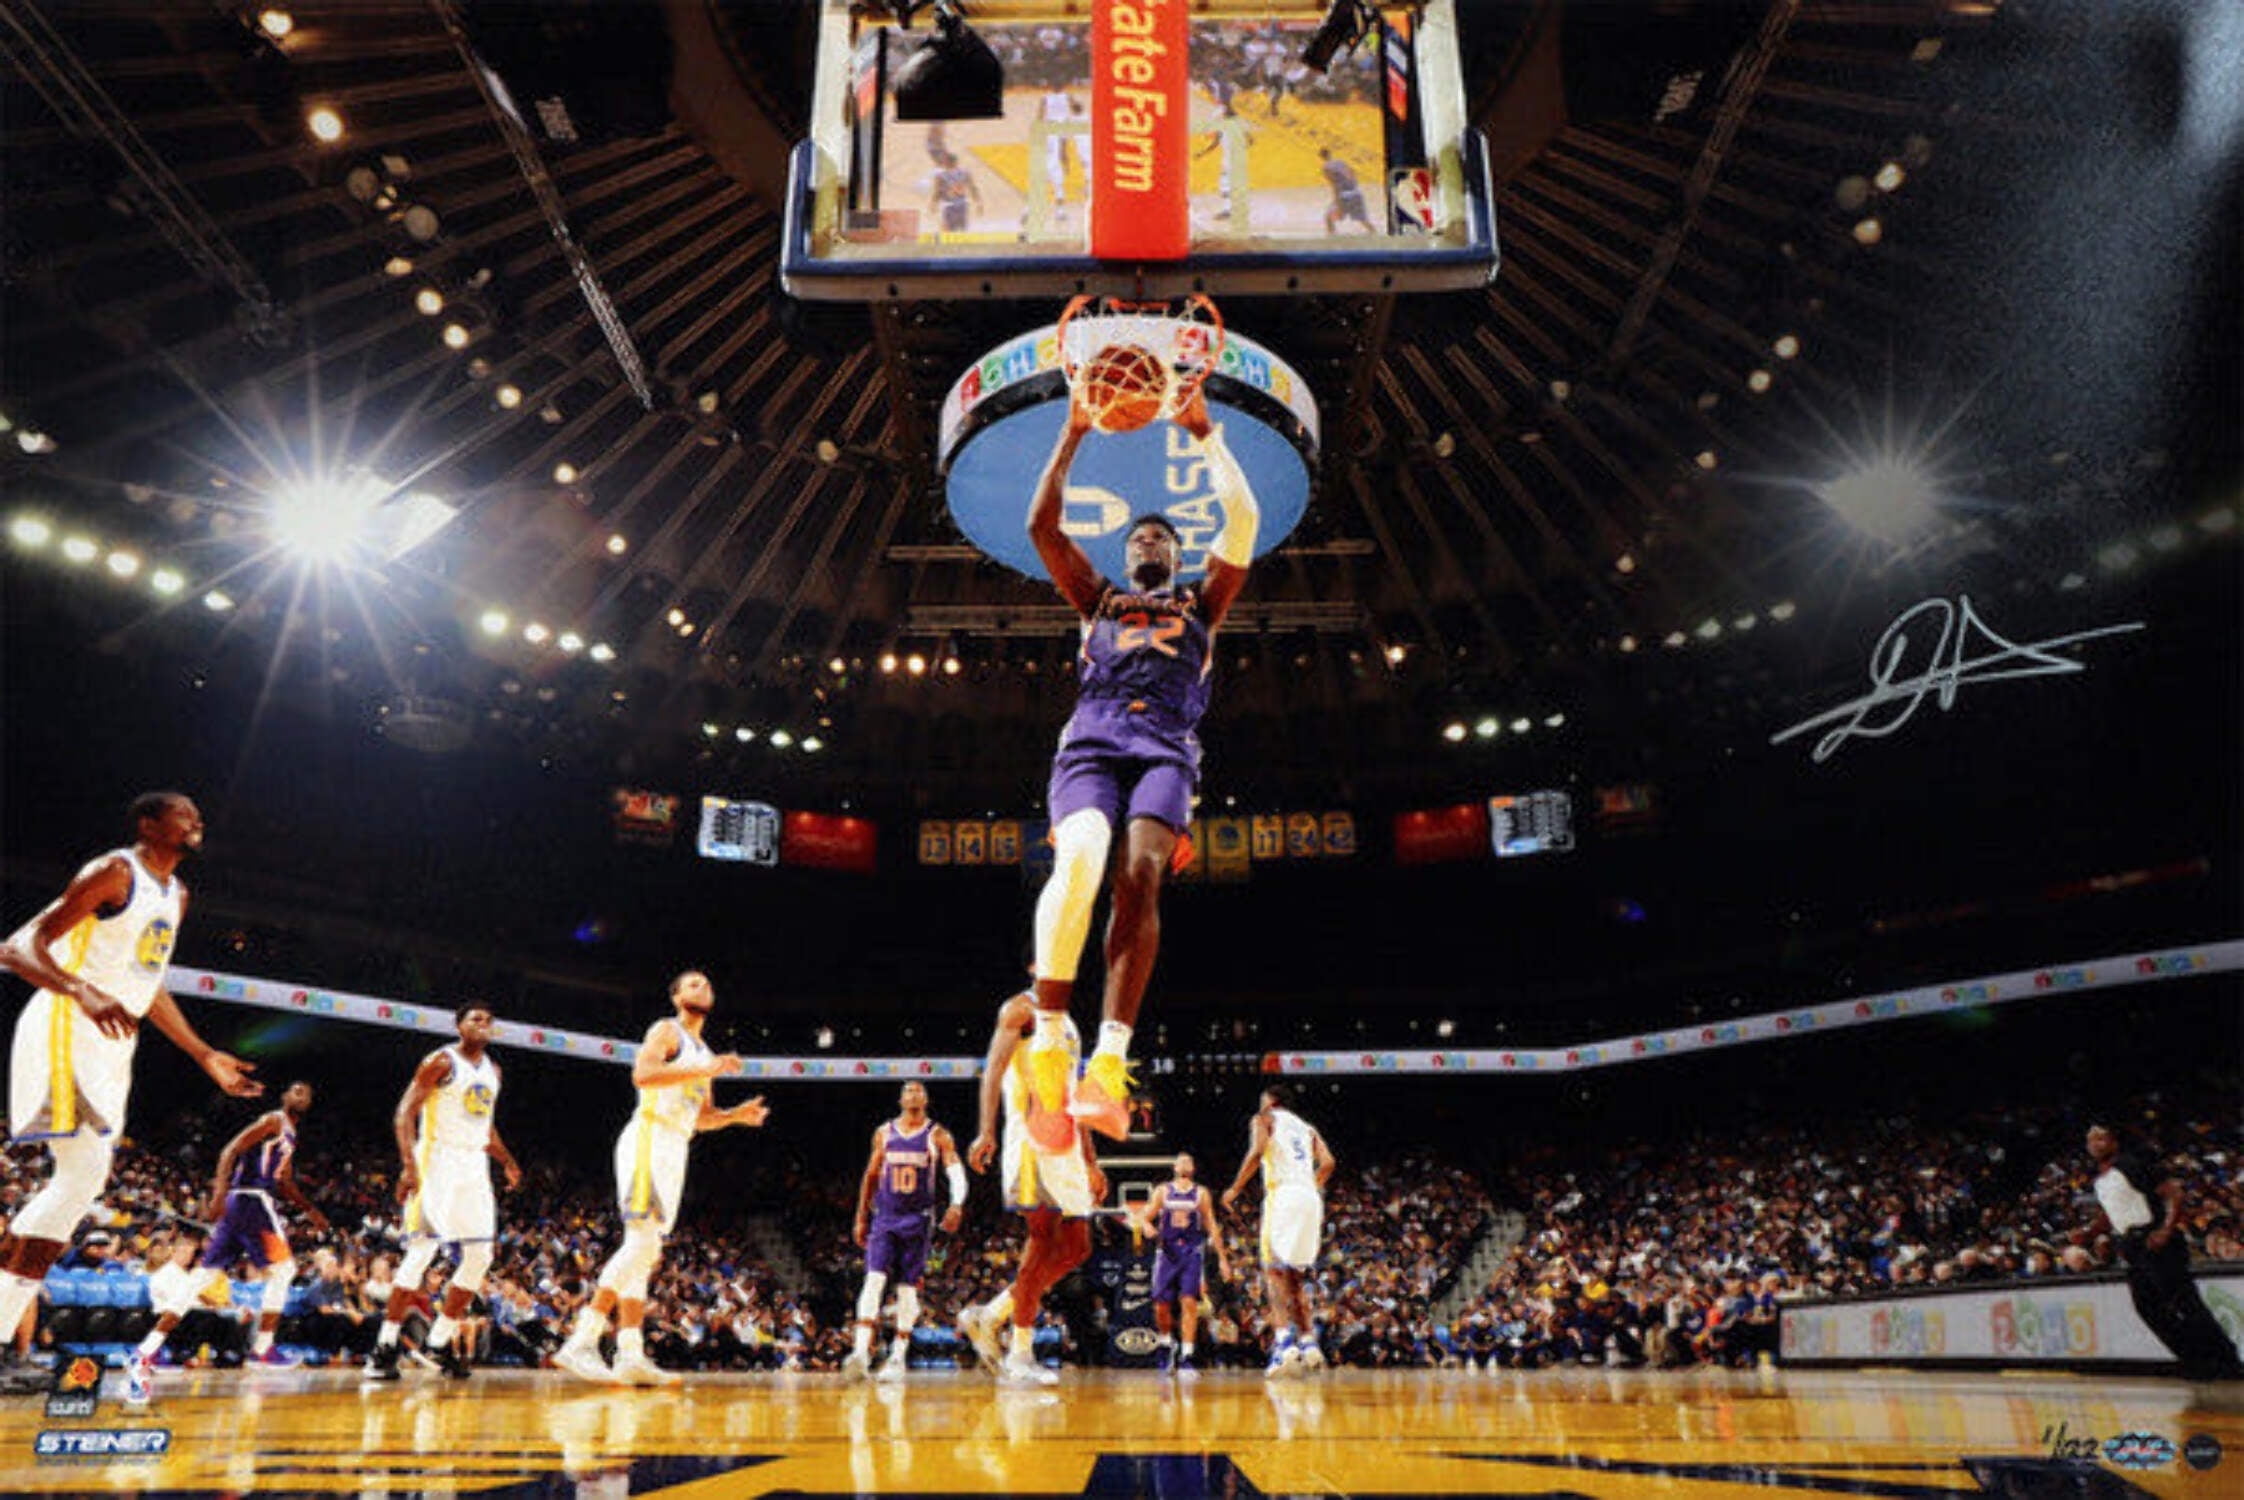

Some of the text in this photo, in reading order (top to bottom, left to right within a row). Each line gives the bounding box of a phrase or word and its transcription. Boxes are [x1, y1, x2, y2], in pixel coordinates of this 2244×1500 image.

[1110, 0, 1168, 192] ateFarm
[1117, 612, 1195, 658] 22
[891, 1166, 917, 1194] 10
